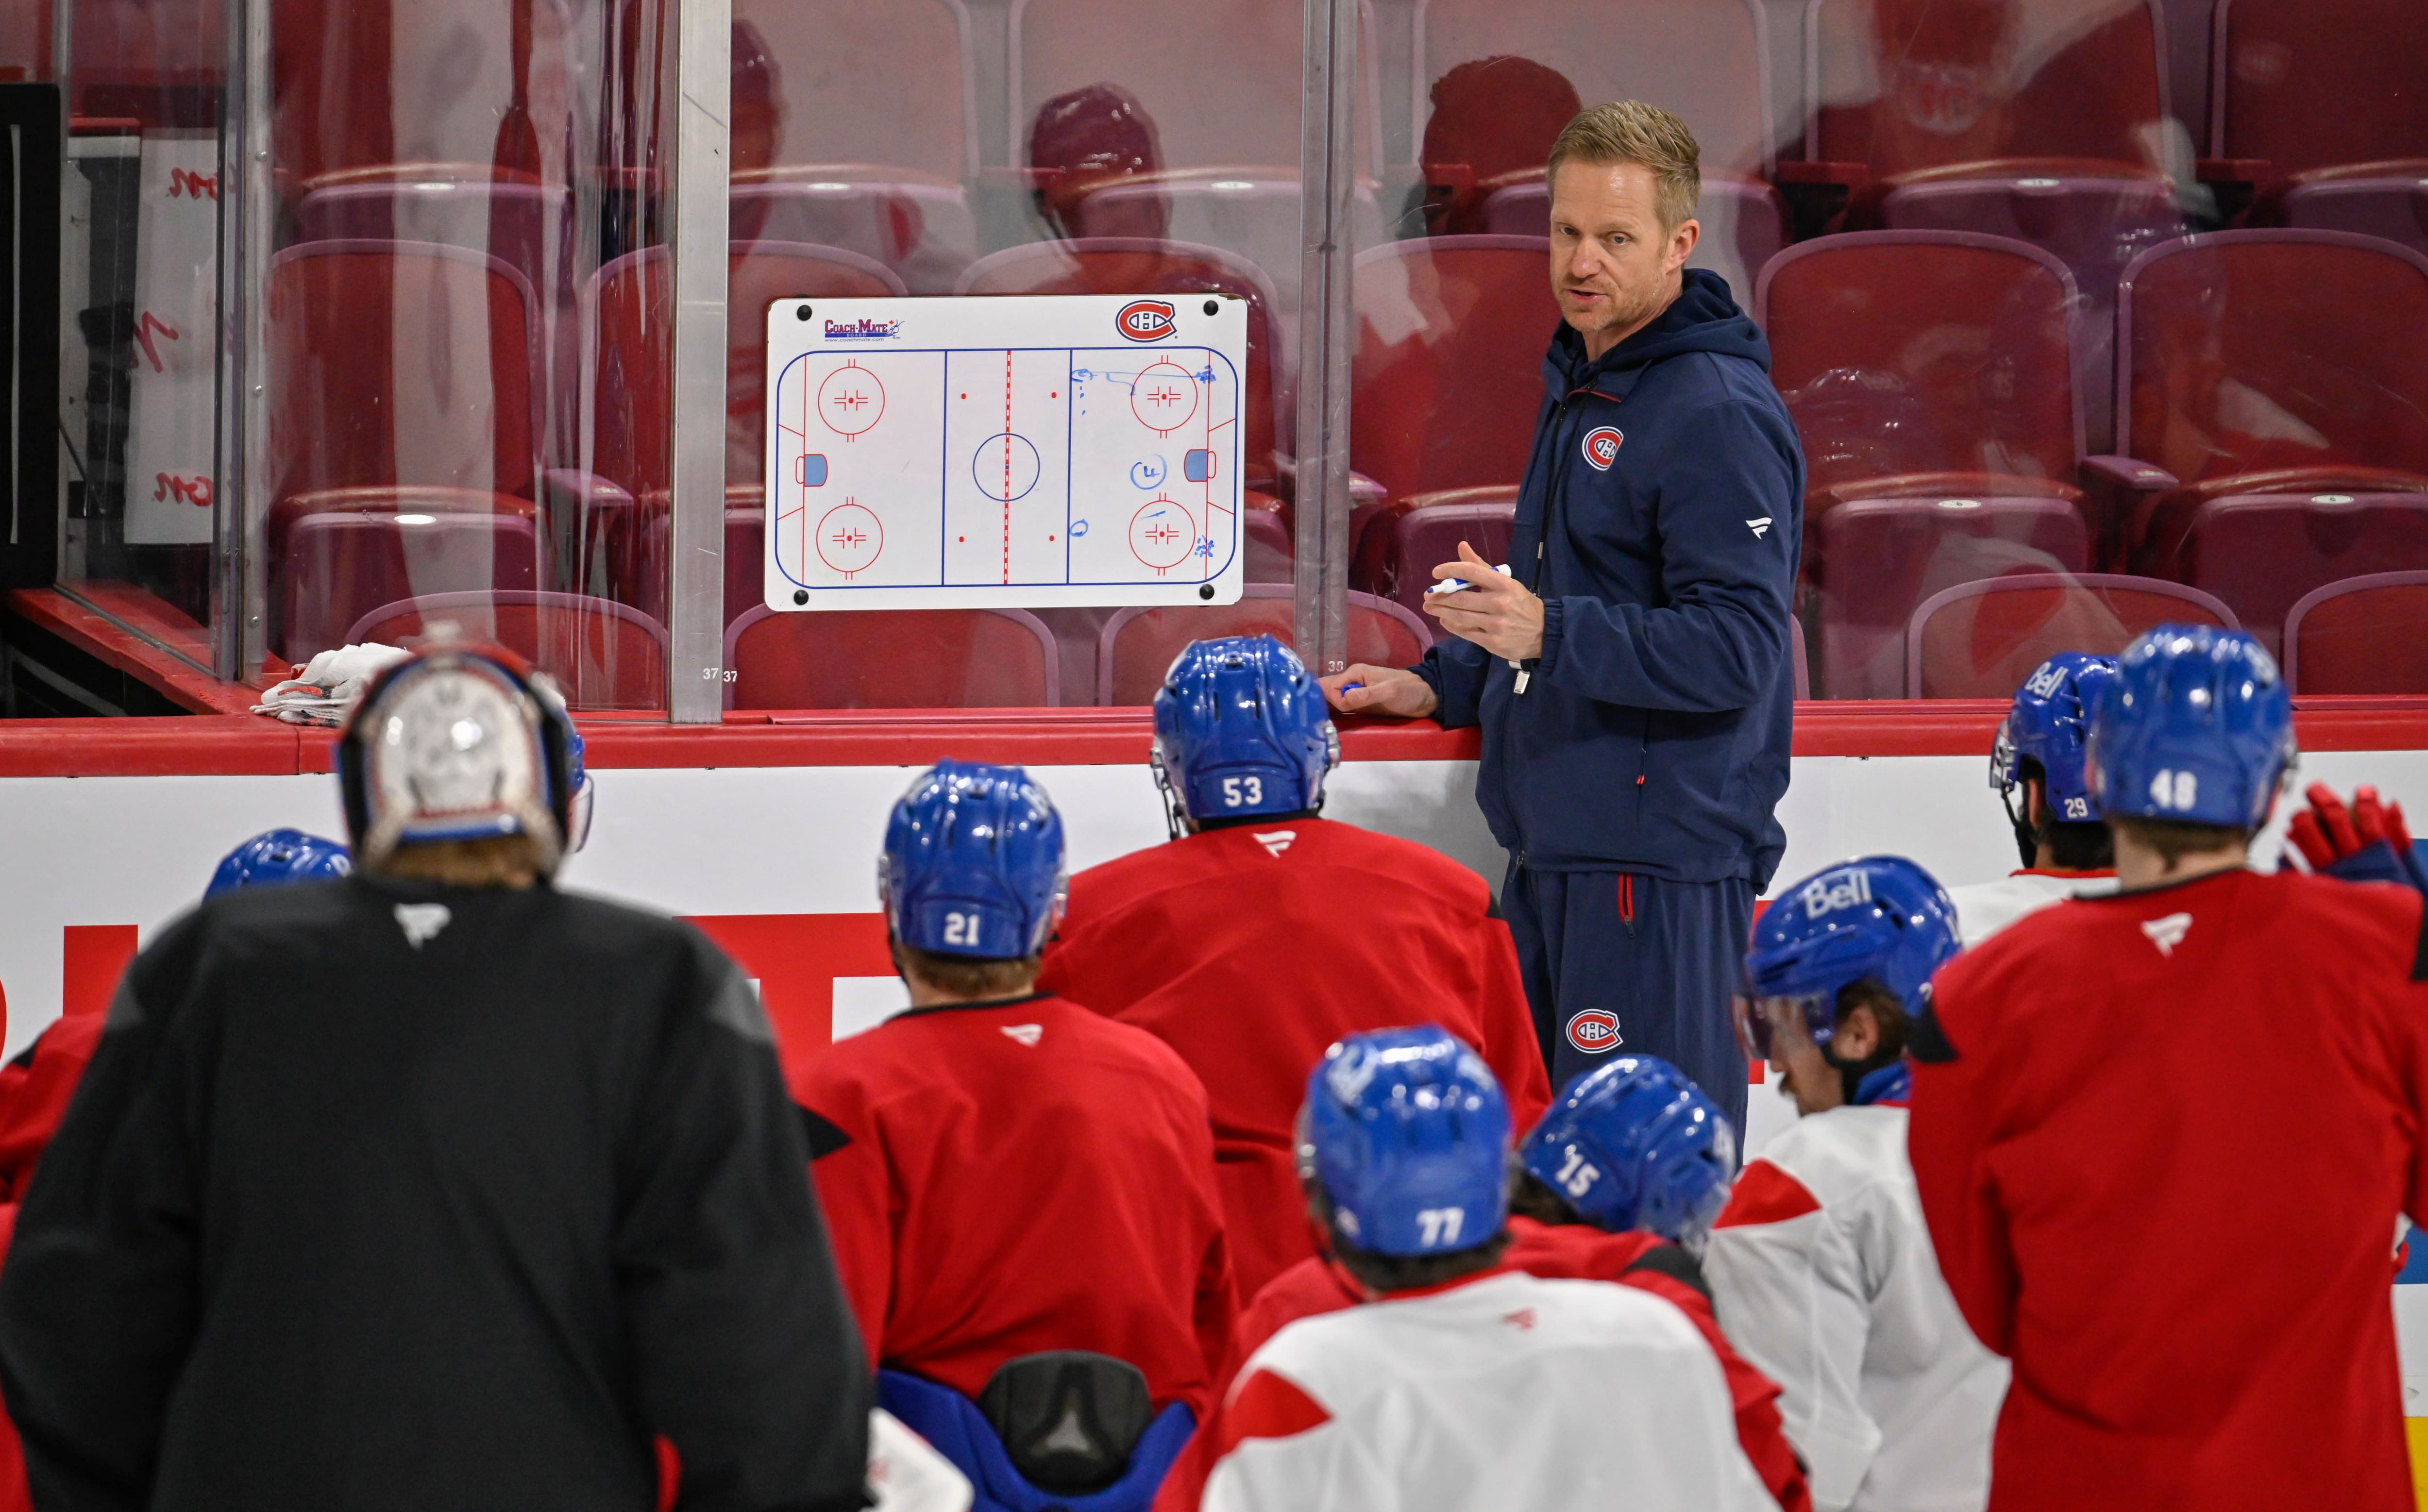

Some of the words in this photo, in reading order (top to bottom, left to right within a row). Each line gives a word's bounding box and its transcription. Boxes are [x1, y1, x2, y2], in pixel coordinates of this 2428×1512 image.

[703, 668, 719, 679] 37
[723, 671, 738, 682] 37
[2024, 661, 2069, 700] Bell
[1223, 776, 1263, 807] 53
[2064, 797, 2088, 819] 29
[2149, 768, 2198, 811] 48
[1802, 868, 1872, 920] Bell
[944, 912, 980, 947] 21
[1554, 1153, 1601, 1198] 15
[1416, 1206, 1465, 1248] 77
